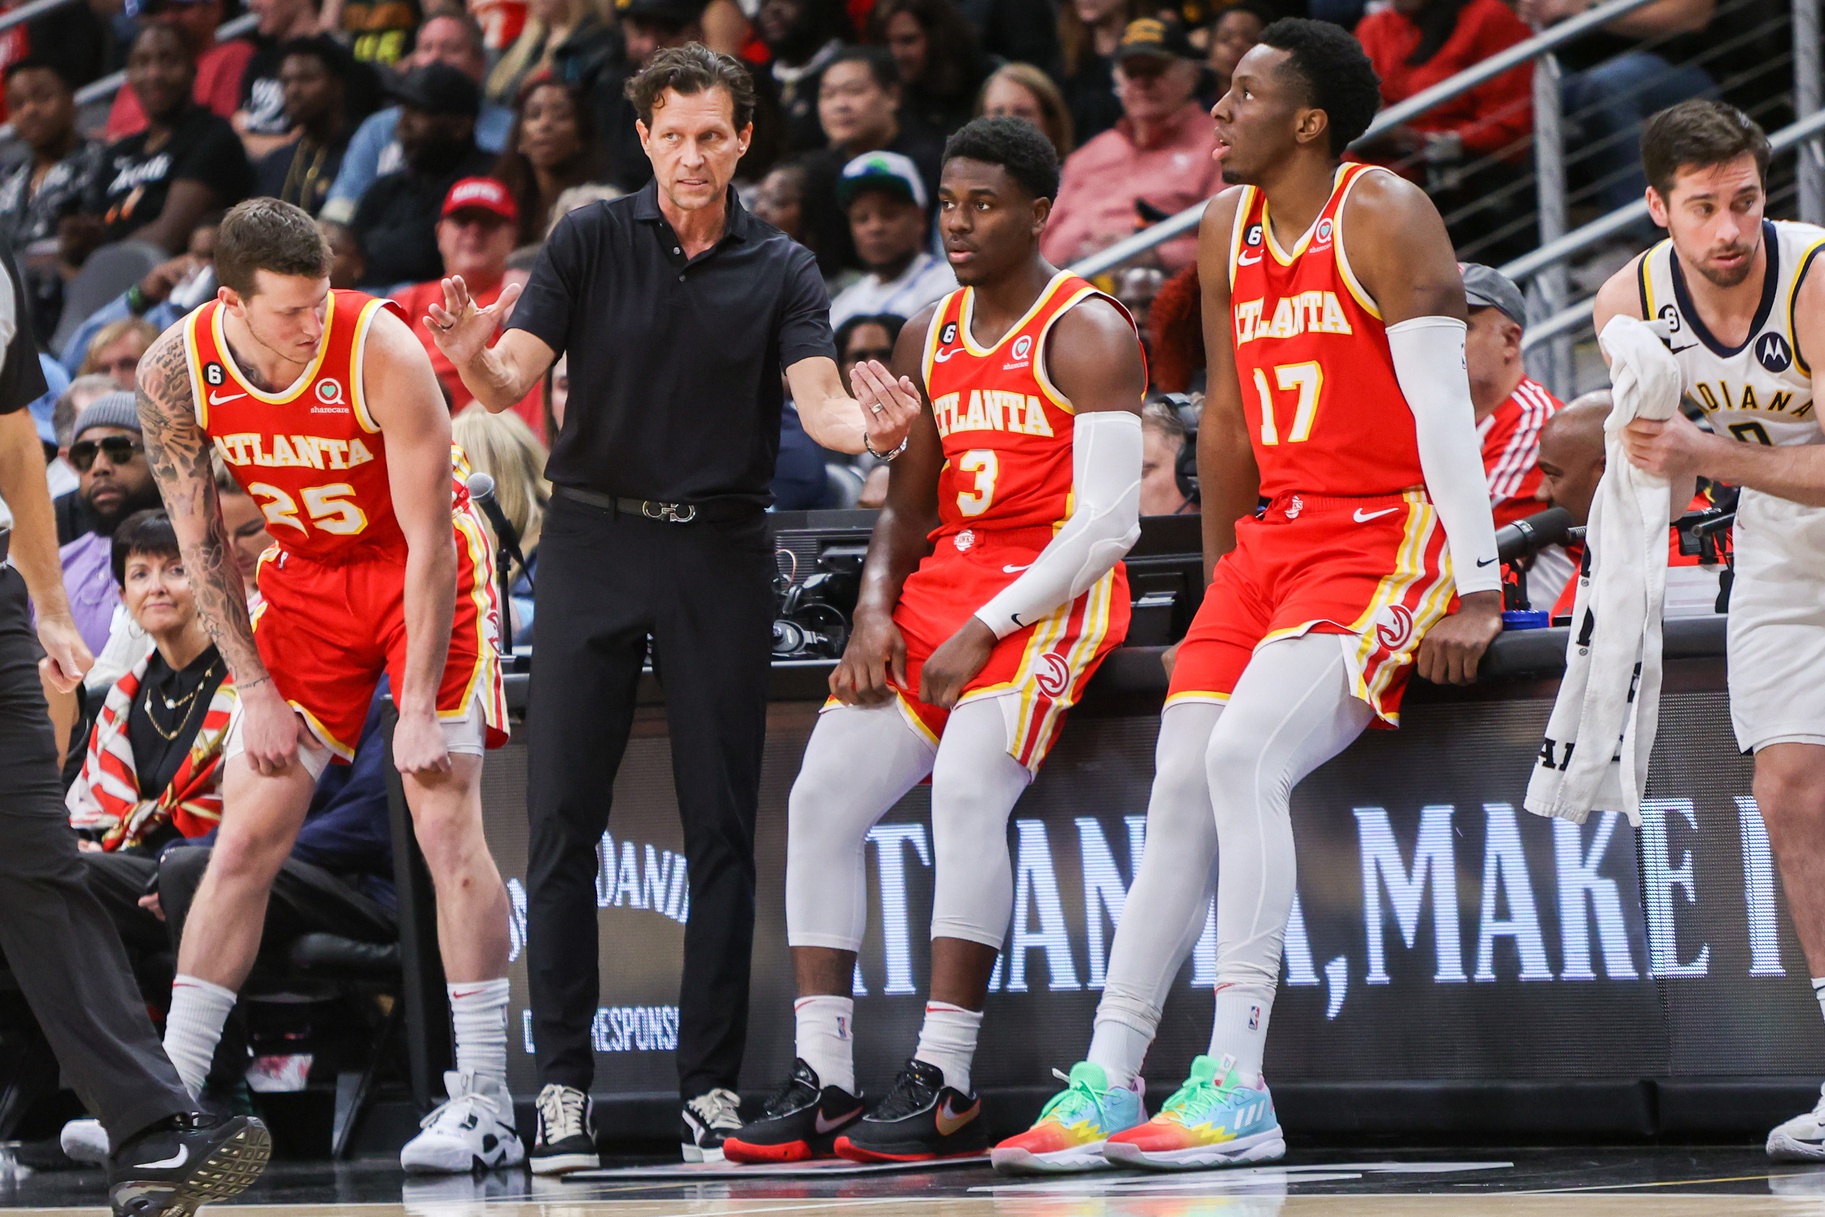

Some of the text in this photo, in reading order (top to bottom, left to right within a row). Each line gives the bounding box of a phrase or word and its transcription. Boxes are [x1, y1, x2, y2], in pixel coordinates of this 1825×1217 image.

[1247, 225, 1263, 246] 6
[942, 324, 957, 344] 6
[1234, 290, 1353, 348] TLANTA
[1665, 304, 1680, 333] 6
[207, 364, 222, 385] 6
[310, 405, 350, 414] sharecare
[932, 388, 1055, 441] TLANTA
[1253, 359, 1324, 446] 17
[247, 481, 369, 540] 25
[956, 448, 999, 518] 3
[594, 829, 690, 925] DANI
[1352, 796, 1710, 985] MAKE
[1732, 795, 1787, 978] I
